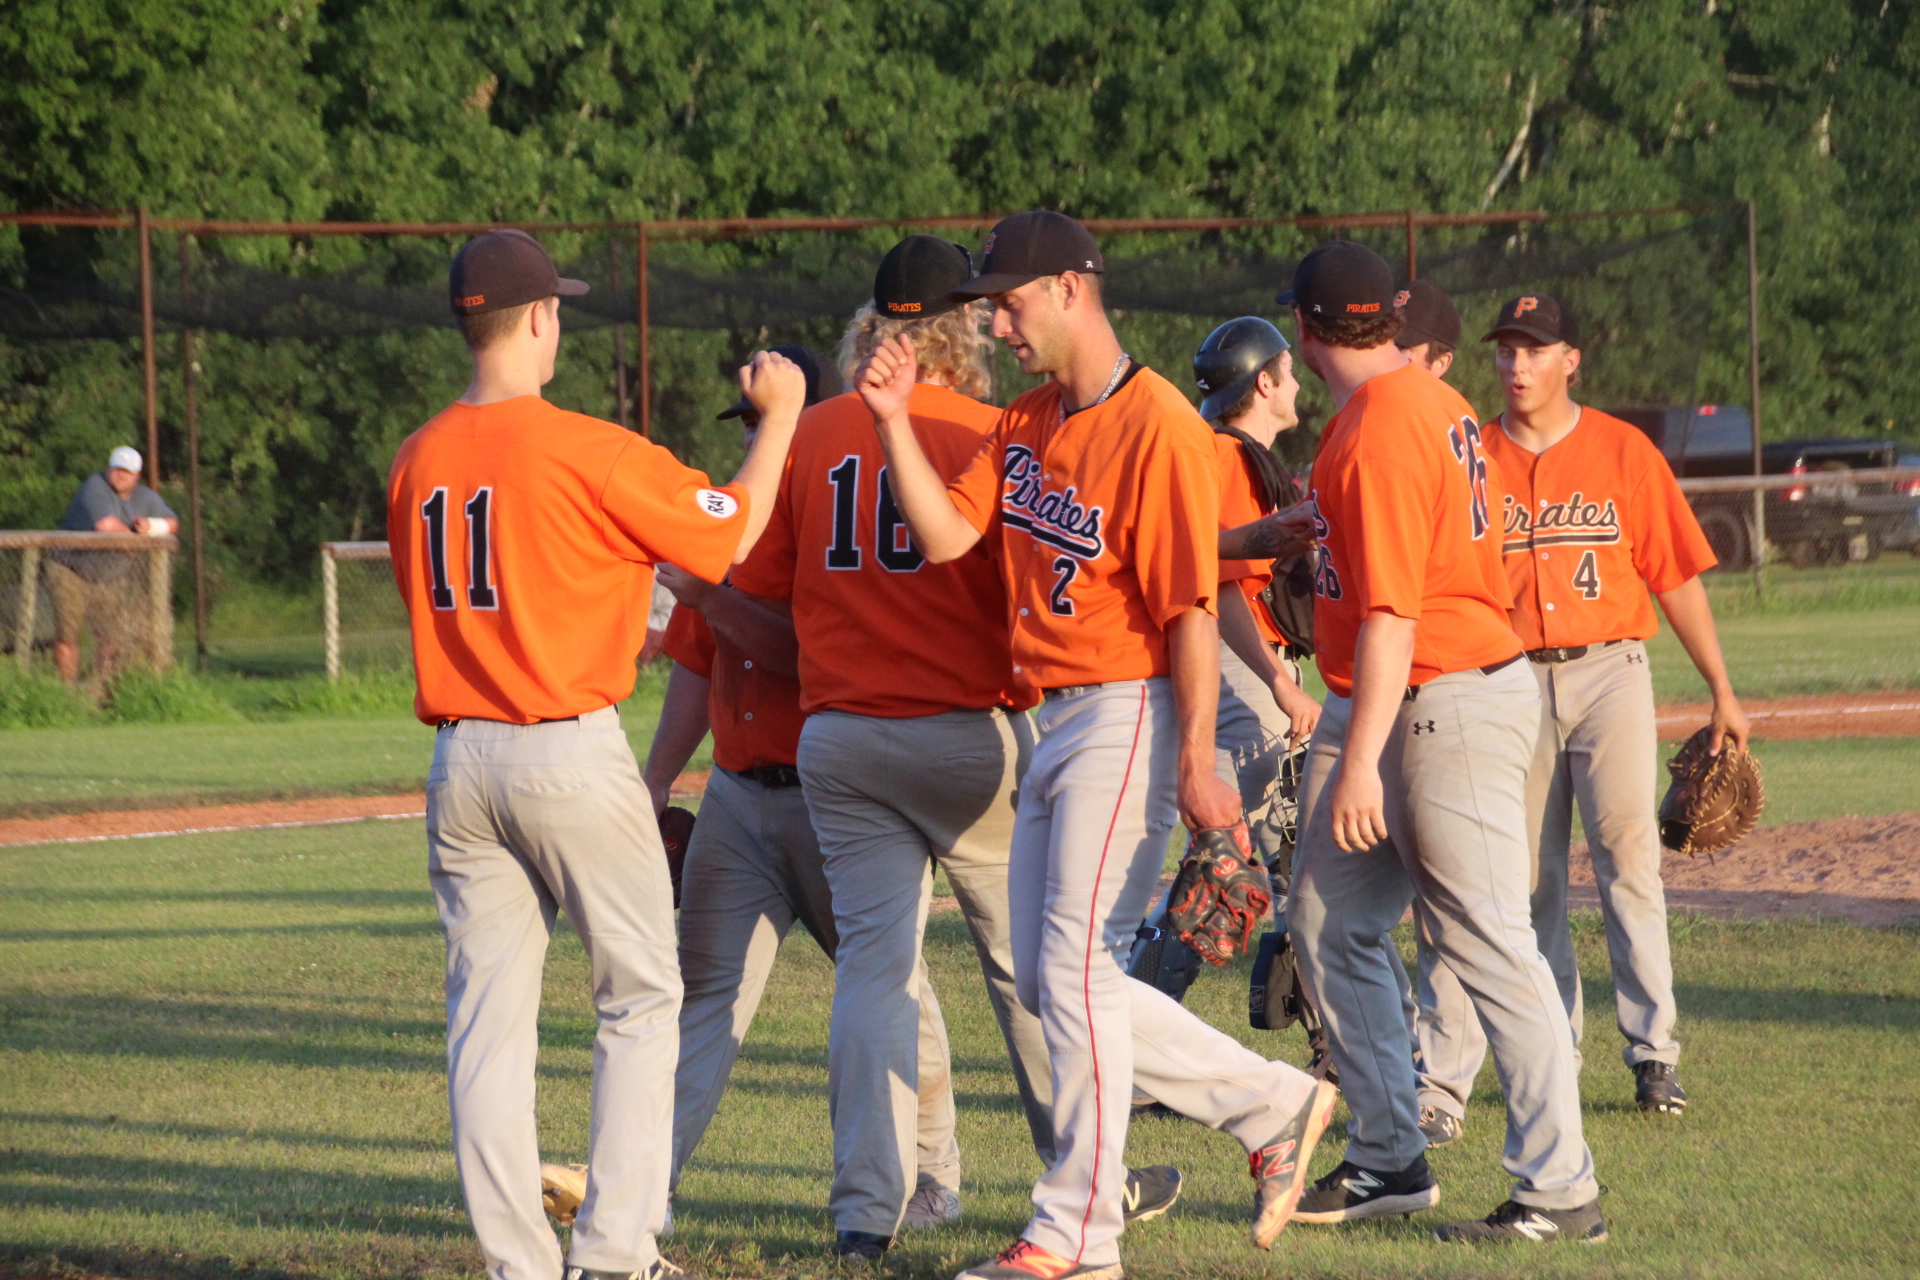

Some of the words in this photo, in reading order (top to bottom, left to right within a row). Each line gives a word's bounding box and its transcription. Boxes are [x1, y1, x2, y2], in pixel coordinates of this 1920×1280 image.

[887, 302, 921, 312] PIRATES
[1346, 303, 1380, 313] PIRATES
[1514, 297, 1538, 318] P
[707, 491, 725, 515] RAY
[1002, 443, 1104, 558] Pirates
[1503, 491, 1620, 548] irates
[421, 486, 500, 611] 11
[1051, 554, 1080, 617] 2
[1571, 549, 1601, 600] 4
